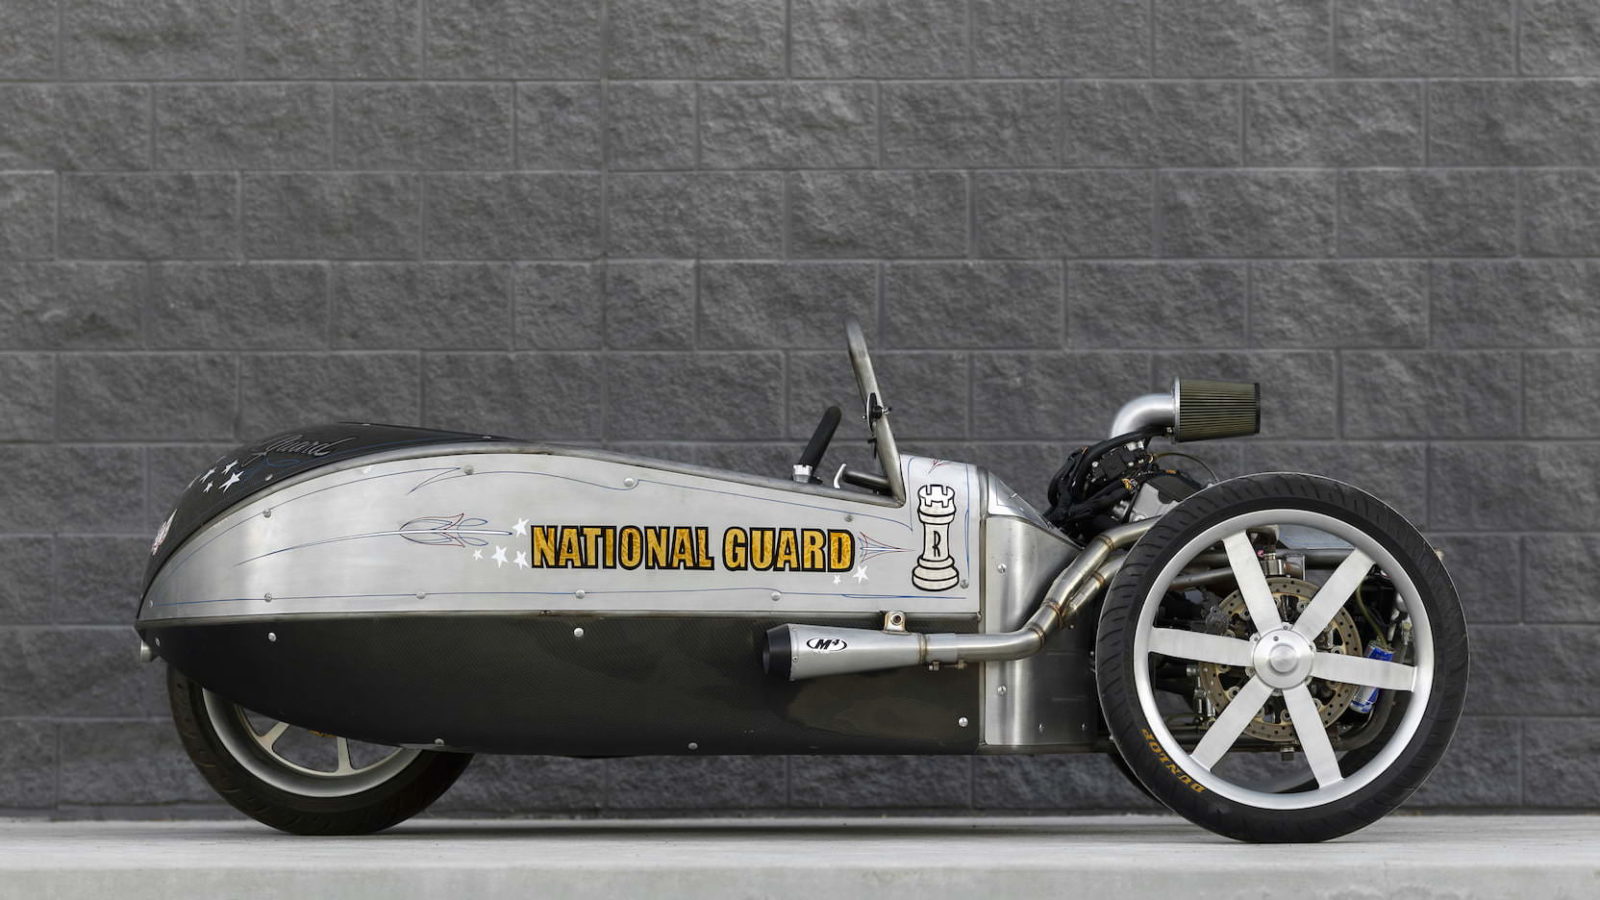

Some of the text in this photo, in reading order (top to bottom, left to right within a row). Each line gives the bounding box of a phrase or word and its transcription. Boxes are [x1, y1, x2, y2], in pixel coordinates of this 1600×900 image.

[531, 525, 855, 572] NATIONAL GUARD
[932, 530, 941, 557] R
[1141, 728, 1206, 793] DUNLOP
